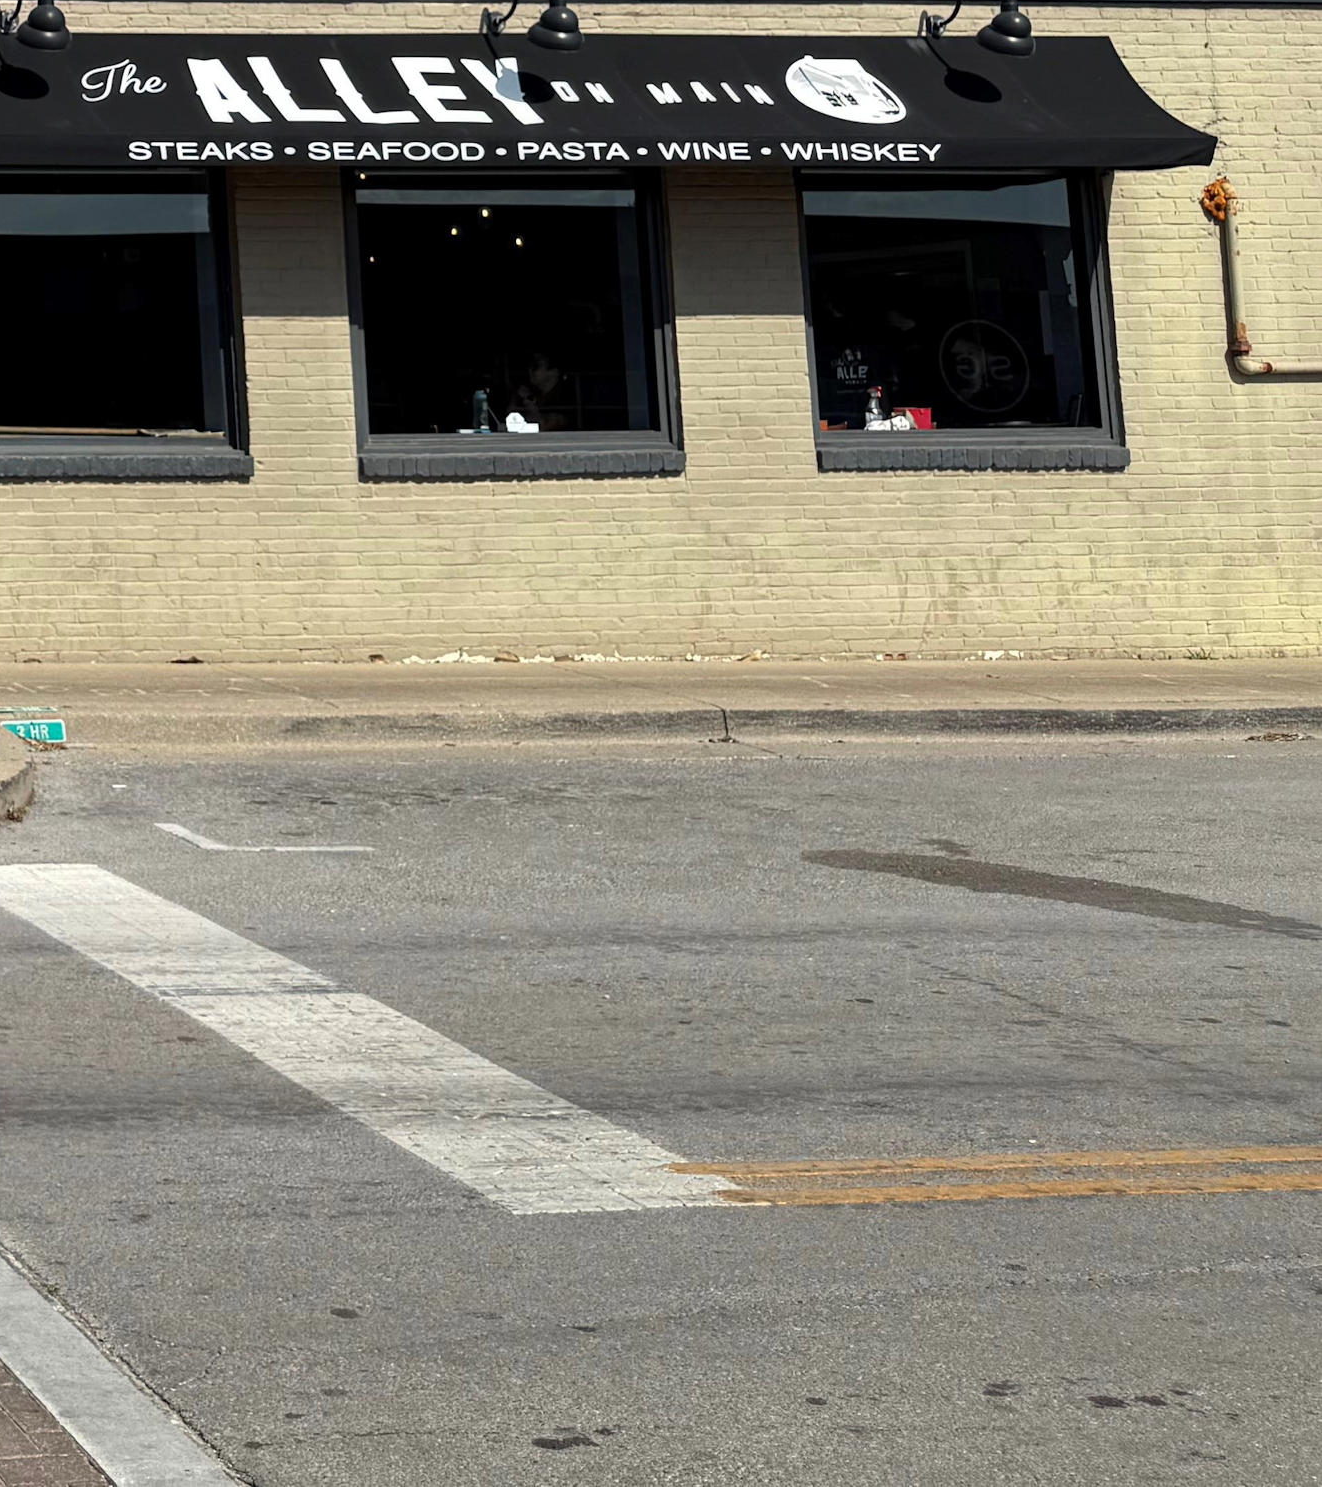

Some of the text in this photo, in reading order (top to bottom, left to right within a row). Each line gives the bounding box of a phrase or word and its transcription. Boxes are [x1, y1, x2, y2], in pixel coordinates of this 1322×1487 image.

[80, 56, 775, 126] The ALLEY ON MAIN
[128, 141, 942, 163] STEAKS SEAFOOD PASTA WINE WHISKEY
[30, 724, 50, 740] HR
